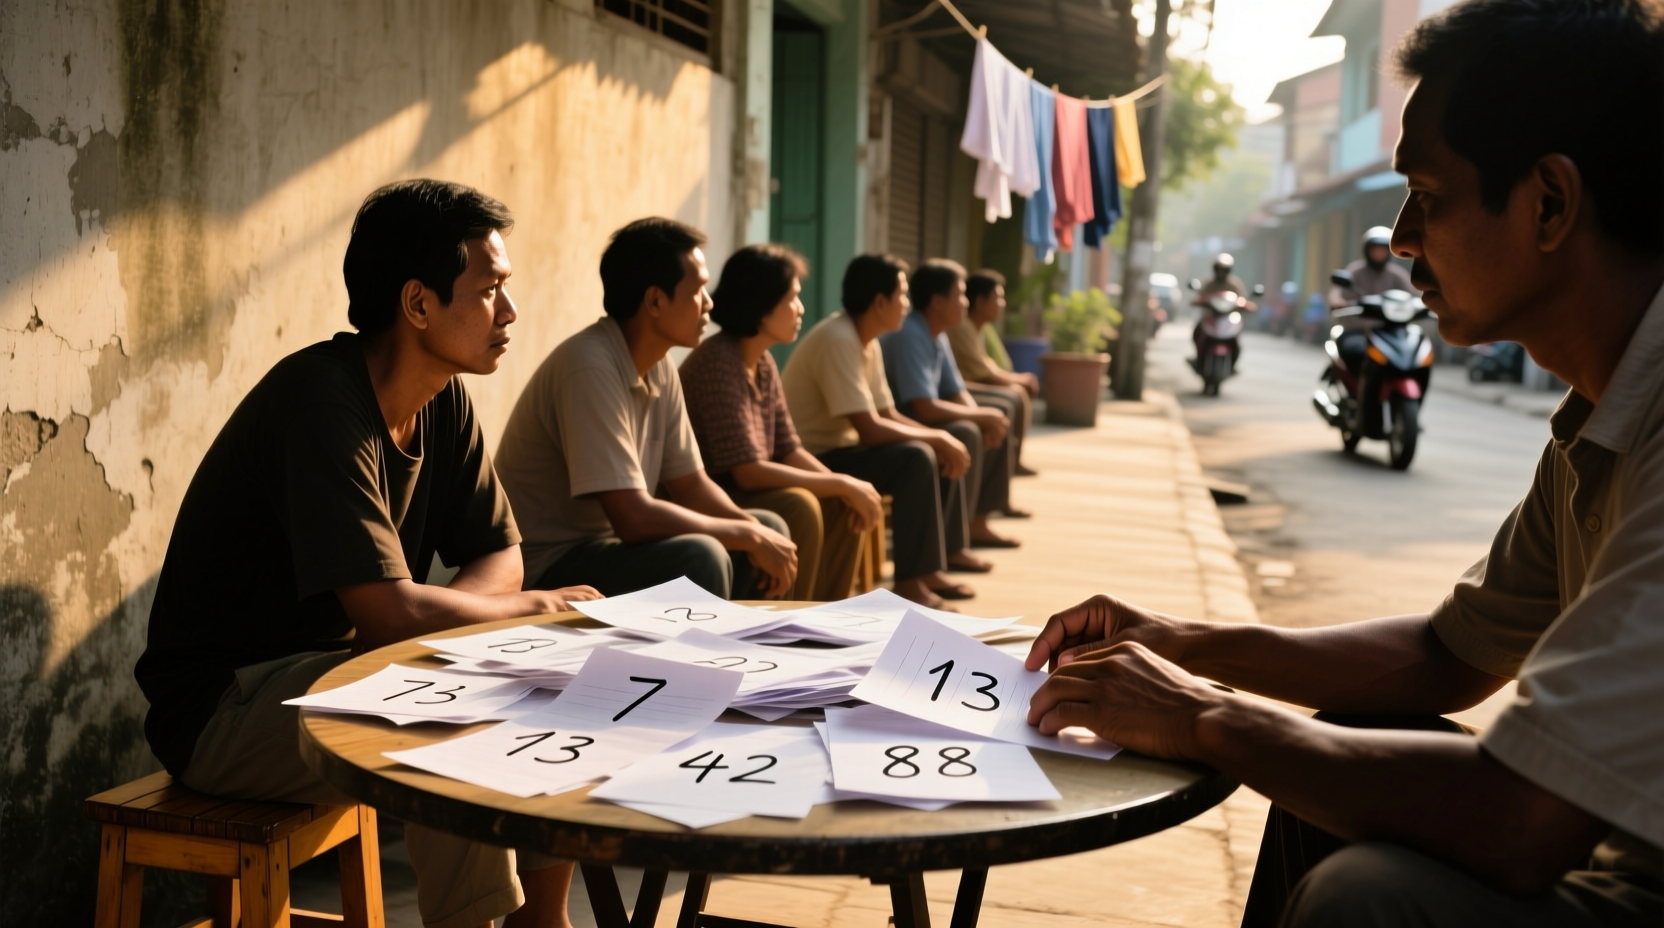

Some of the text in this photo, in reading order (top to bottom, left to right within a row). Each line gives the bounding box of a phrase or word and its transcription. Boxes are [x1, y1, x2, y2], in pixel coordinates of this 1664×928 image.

[612, 675, 668, 722] 7
[928, 659, 1000, 711] 13
[506, 731, 595, 764] 13
[882, 745, 977, 778] 88
[678, 750, 778, 784] 42
